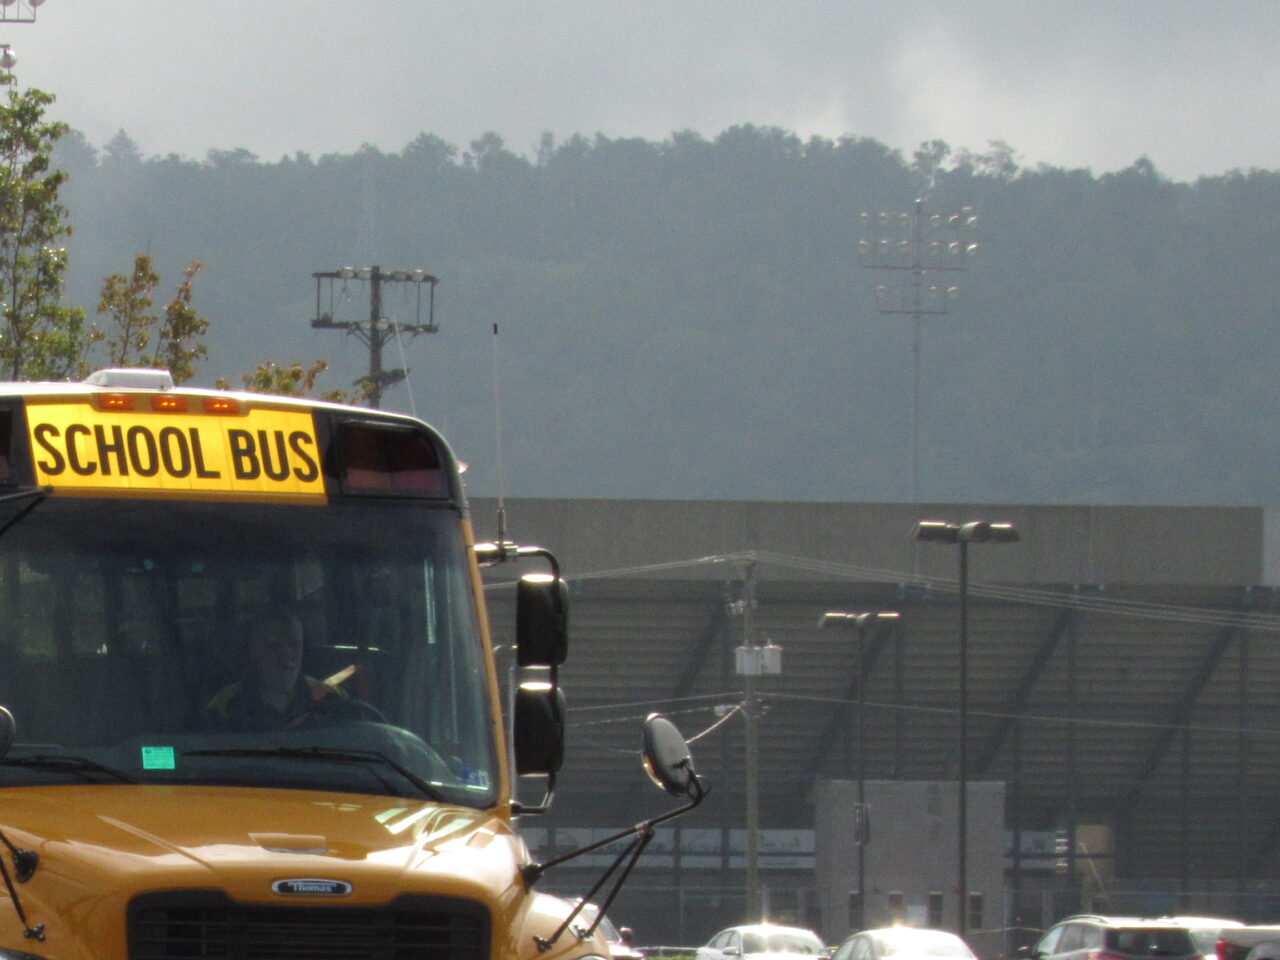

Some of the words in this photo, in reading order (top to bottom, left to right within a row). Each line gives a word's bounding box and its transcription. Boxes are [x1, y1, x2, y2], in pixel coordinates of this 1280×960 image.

[33, 423, 221, 479] SCHOOL
[227, 429, 319, 482] BUS
[287, 880, 337, 893] Thomas
